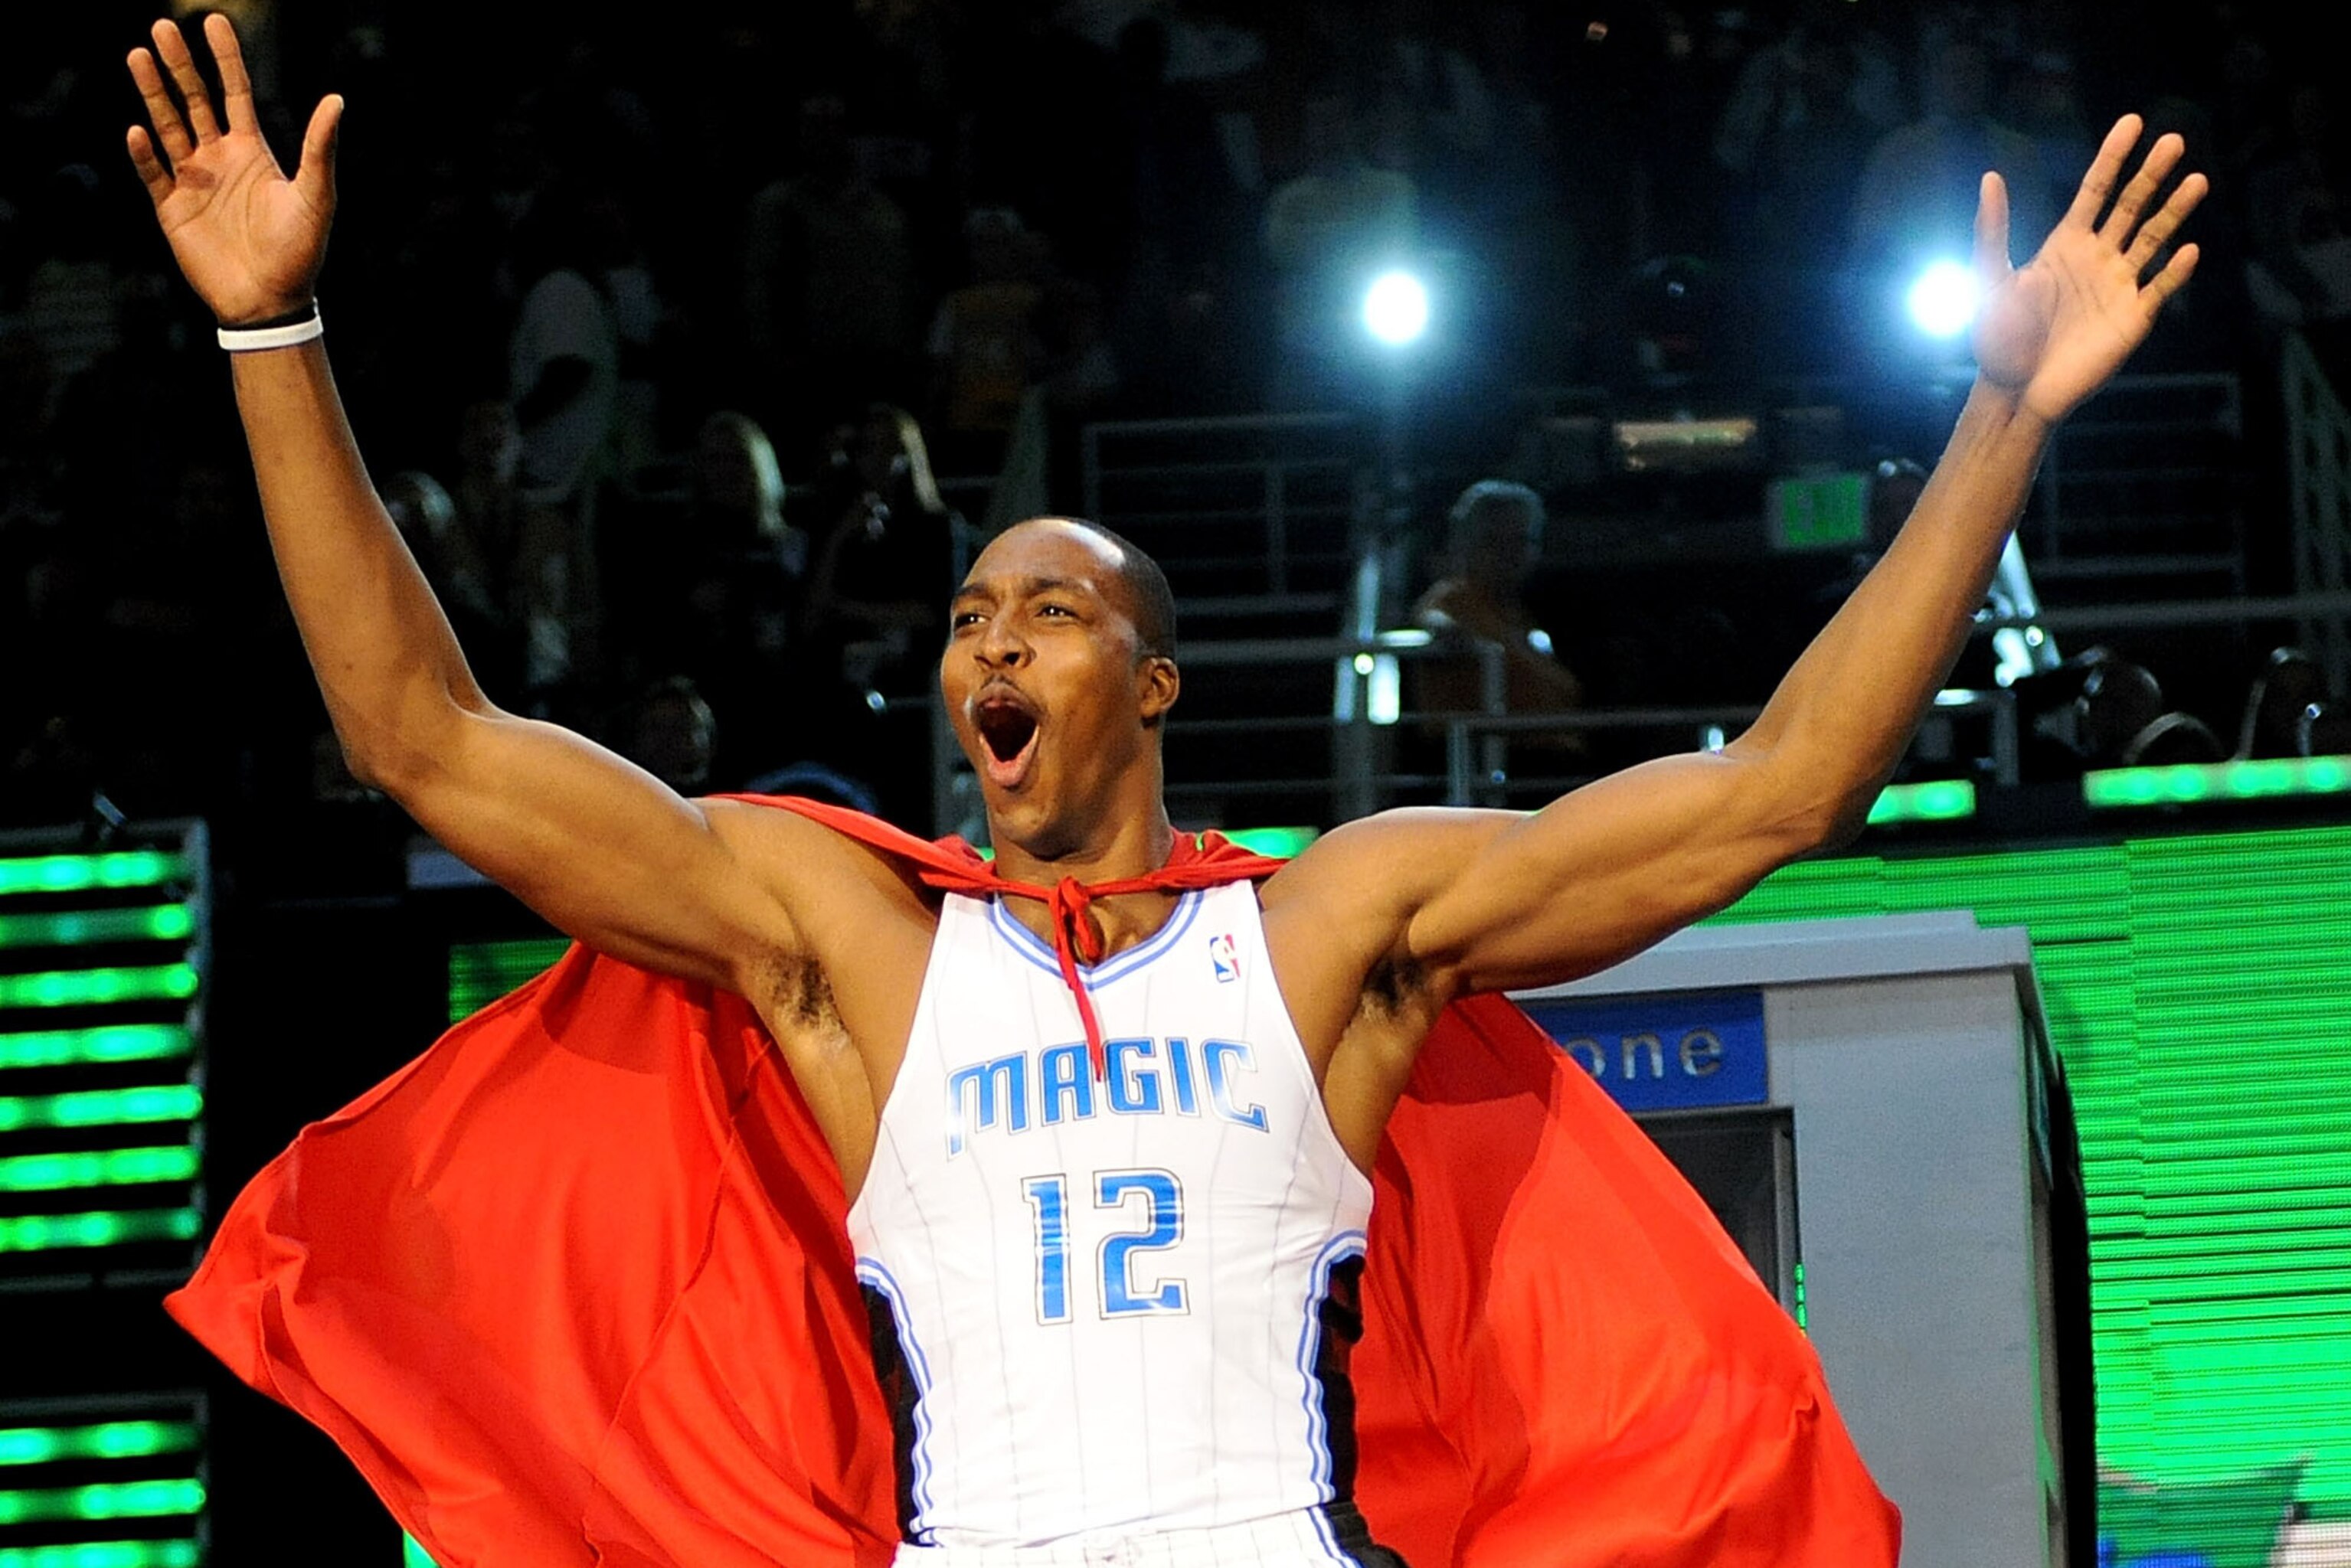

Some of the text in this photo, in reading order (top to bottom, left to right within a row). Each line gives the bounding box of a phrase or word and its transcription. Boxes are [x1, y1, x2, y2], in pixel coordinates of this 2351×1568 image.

[947, 1037, 1270, 1161] MAGIC
[1565, 1026, 1722, 1080] one
[1021, 1168, 1190, 1325] 12
